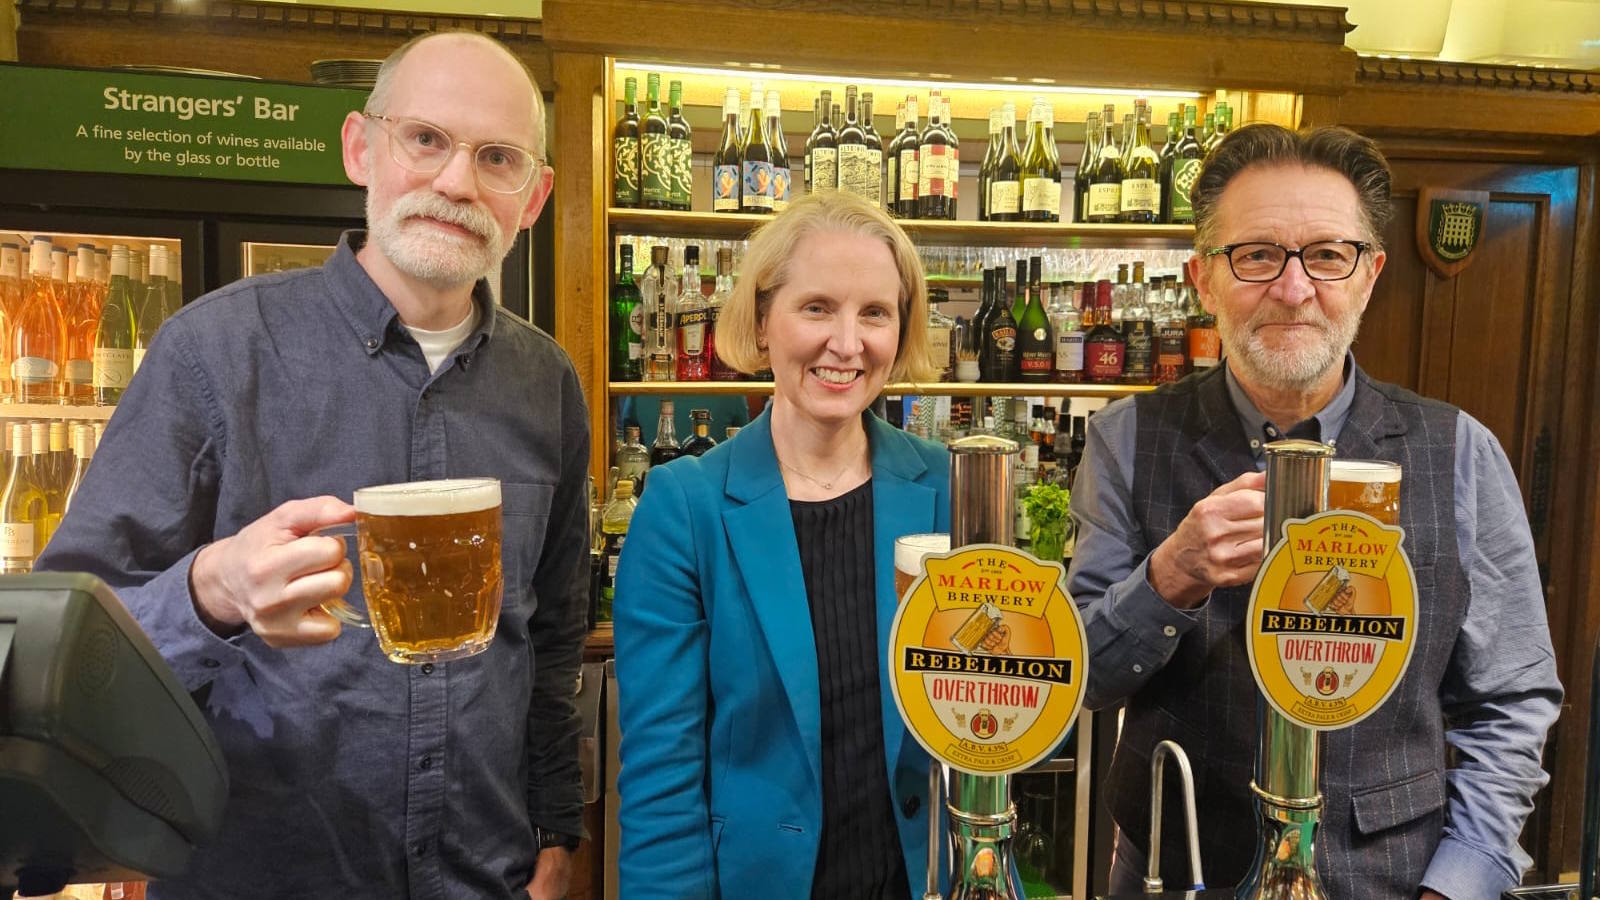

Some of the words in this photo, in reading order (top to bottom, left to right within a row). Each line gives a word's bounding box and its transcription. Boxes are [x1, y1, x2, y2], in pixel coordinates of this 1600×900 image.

[254, 97, 300, 121] Bar
[76, 124, 88, 138] A
[92, 125, 122, 140] fine
[126, 128, 192, 144] selection
[196, 131, 213, 145] of
[216, 134, 259, 148] wines
[263, 136, 326, 152] available
[124, 147, 143, 164] by
[146, 148, 171, 163] the
[176, 151, 211, 167] glass
[216, 154, 232, 166] or
[236, 154, 280, 169] bottle
[1098, 351, 1118, 365] 46
[1331, 522, 1358, 533] THE
[1296, 539, 1388, 556] MARLOW
[976, 557, 1007, 569] THE
[1304, 556, 1378, 569] BREWERY
[938, 574, 1046, 593] MARLOW
[947, 592, 1035, 606] BREWERY
[1268, 615, 1400, 635] REBELLION
[1285, 639, 1376, 664] OVERTHROW
[911, 652, 1064, 679] REBELLION
[932, 678, 1040, 709] OVERTHROW
